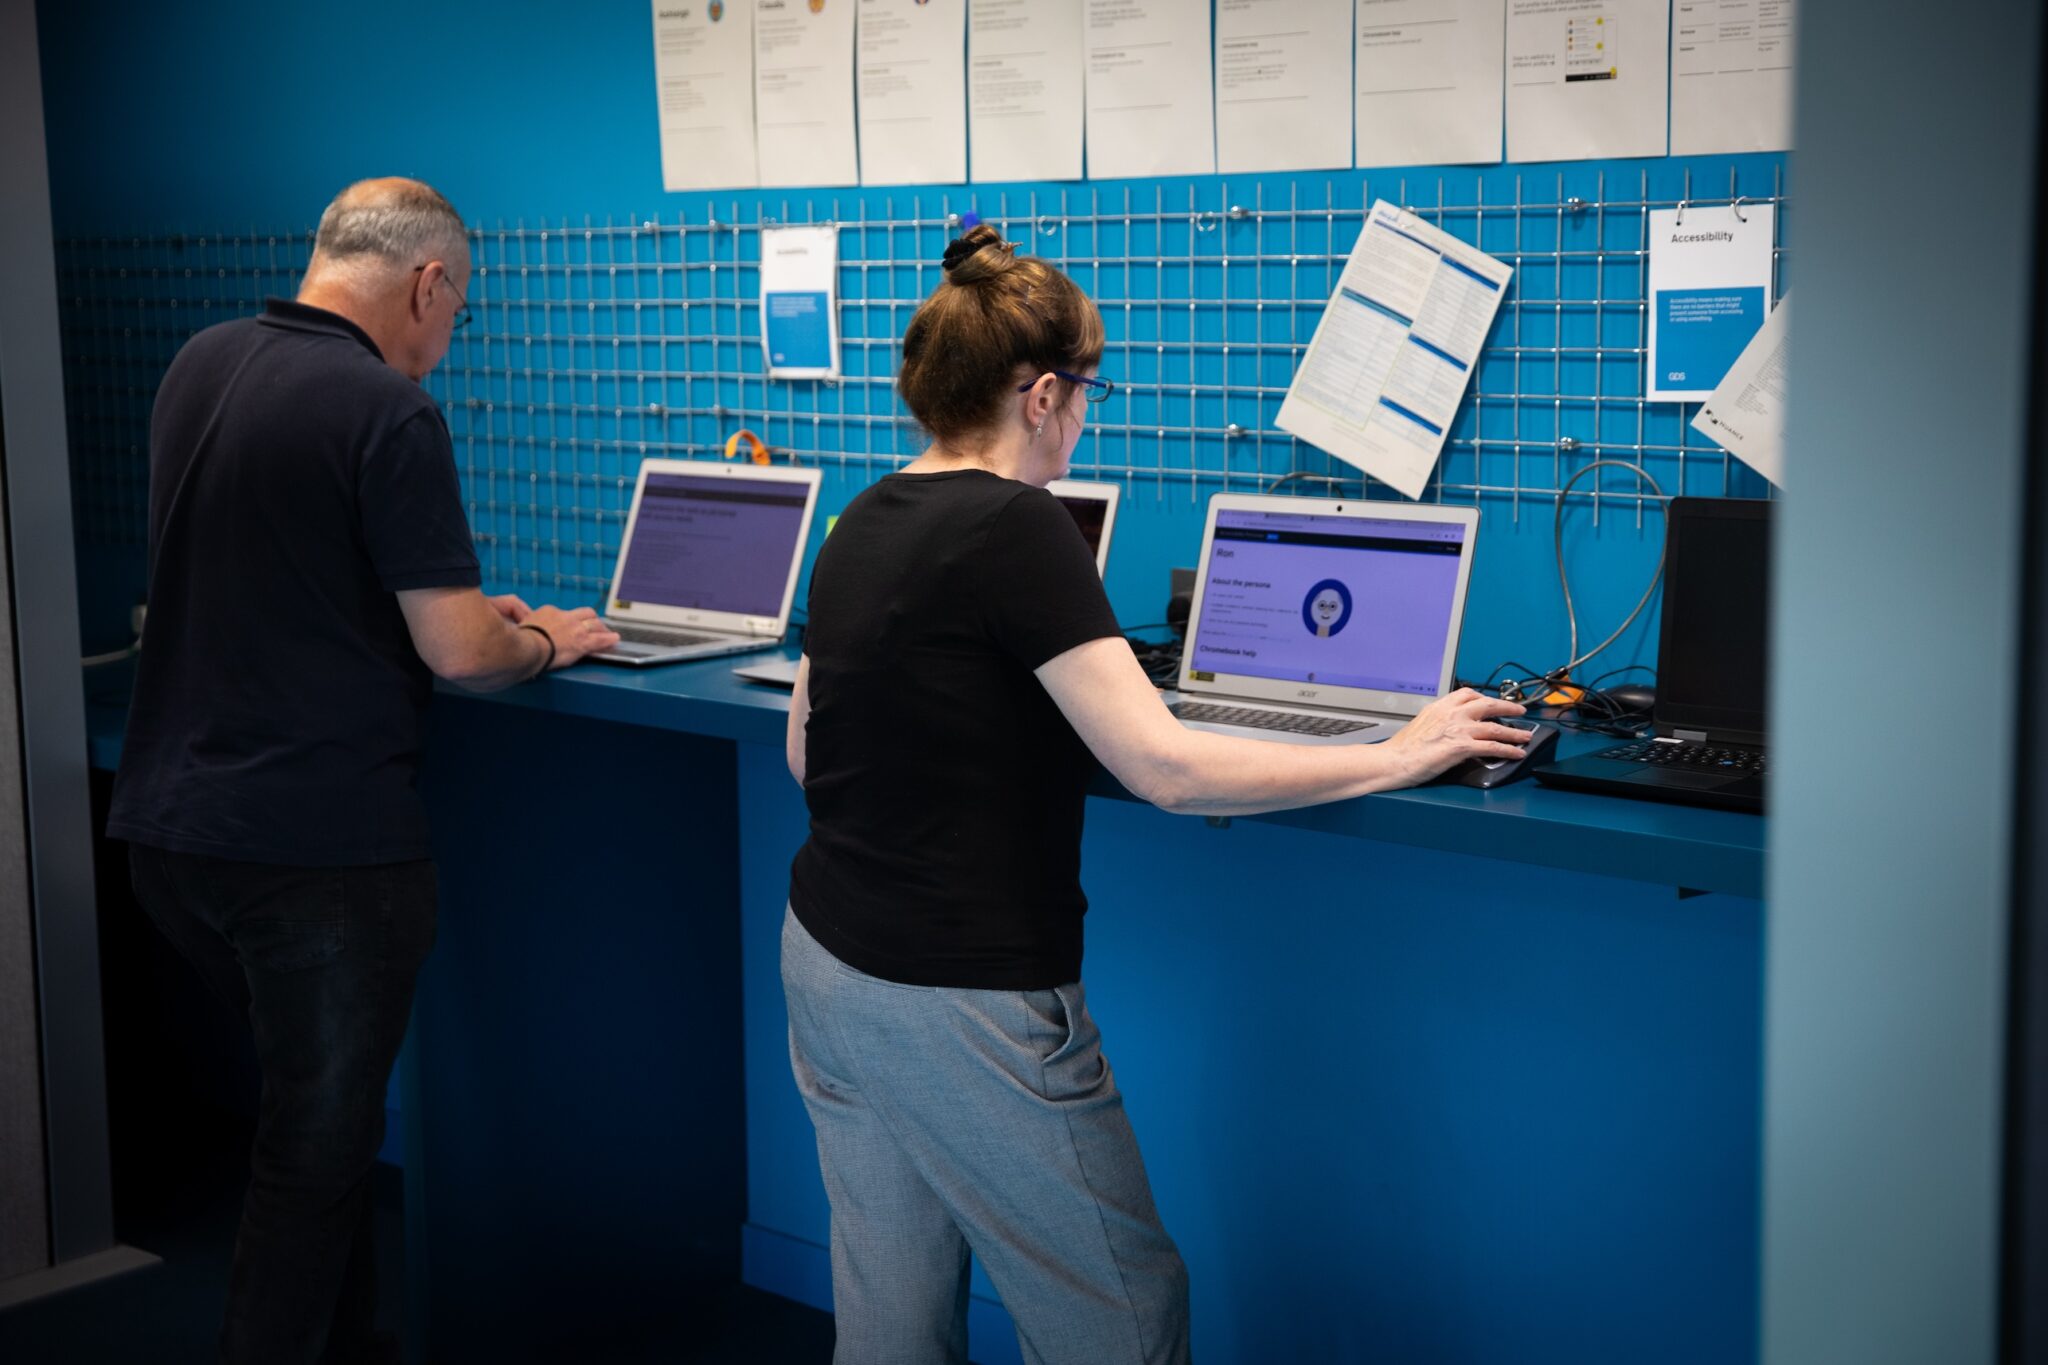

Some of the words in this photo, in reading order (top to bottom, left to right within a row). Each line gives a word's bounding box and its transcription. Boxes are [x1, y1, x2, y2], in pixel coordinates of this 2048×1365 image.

[1671, 231, 1734, 244] Accessibility
[1668, 371, 1686, 381] GDS
[1216, 548, 1235, 558] Ron
[1212, 577, 1231, 586] About
[1232, 579, 1243, 587] the
[1244, 581, 1271, 590] persona
[1200, 645, 1241, 655] Chromebook
[1242, 648, 1257, 659] help
[1297, 690, 1319, 698] acer
